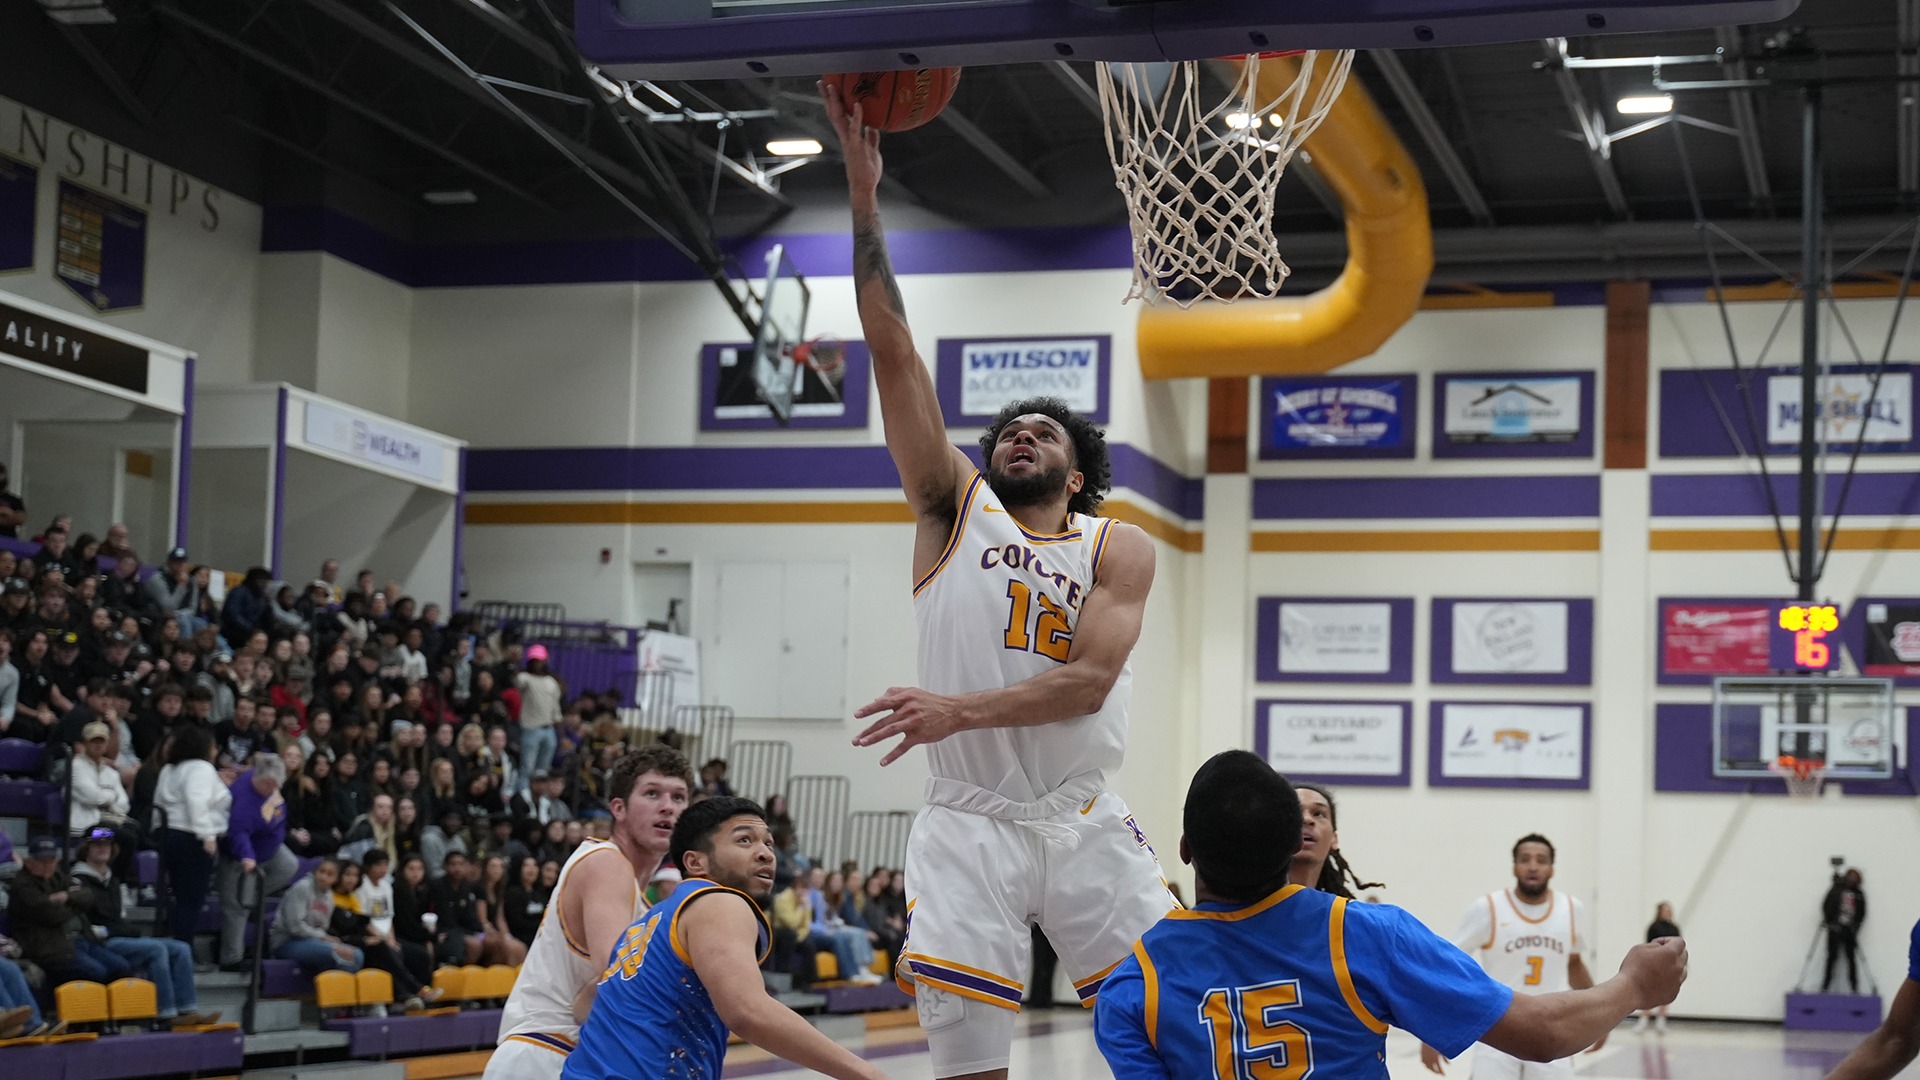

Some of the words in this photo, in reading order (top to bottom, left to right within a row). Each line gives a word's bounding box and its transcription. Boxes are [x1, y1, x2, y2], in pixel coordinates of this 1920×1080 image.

[4, 319, 84, 362] ALITY
[969, 349, 1091, 369] WILSON
[1778, 399, 1901, 428] MSHALL
[369, 432, 421, 464] WEALTH
[980, 544, 1088, 614] COYOTE
[1003, 578, 1074, 665] 12
[1795, 630, 1831, 669] 16
[1504, 935, 1564, 954] COYOTES
[1524, 956, 1544, 986] 3
[1197, 978, 1315, 1080] 15
